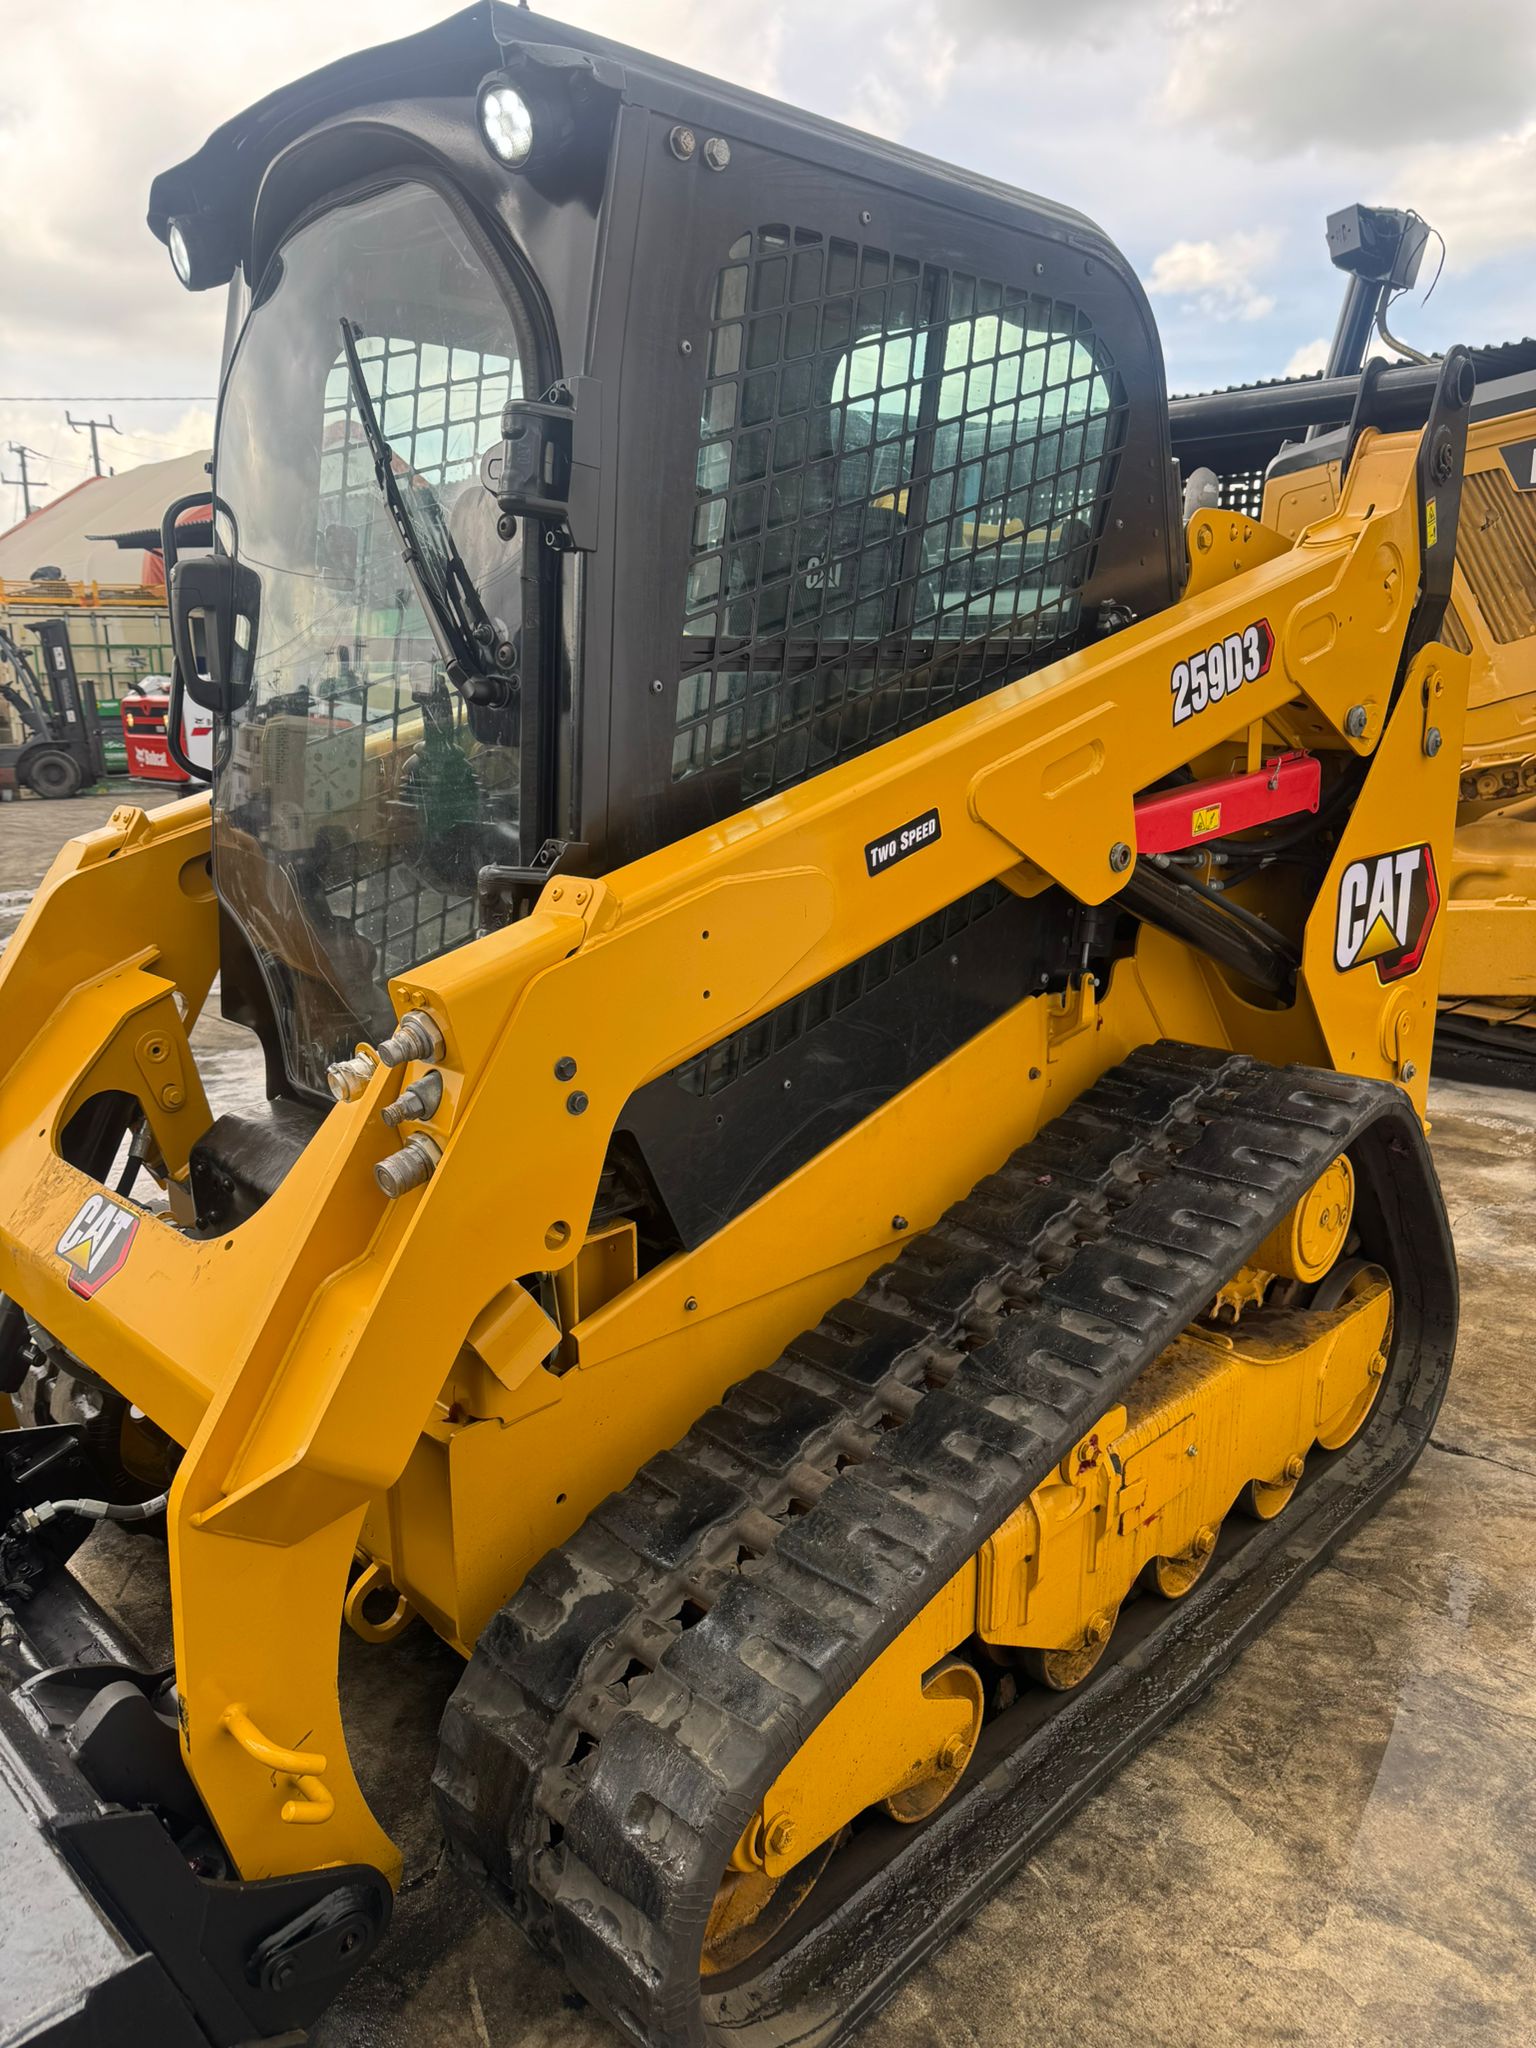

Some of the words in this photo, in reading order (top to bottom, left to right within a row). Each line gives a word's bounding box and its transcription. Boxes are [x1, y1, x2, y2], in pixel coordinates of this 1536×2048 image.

[1171, 625, 1261, 725] 259D3
[1336, 848, 1421, 968] CAT
[57, 1194, 134, 1274] CAT
